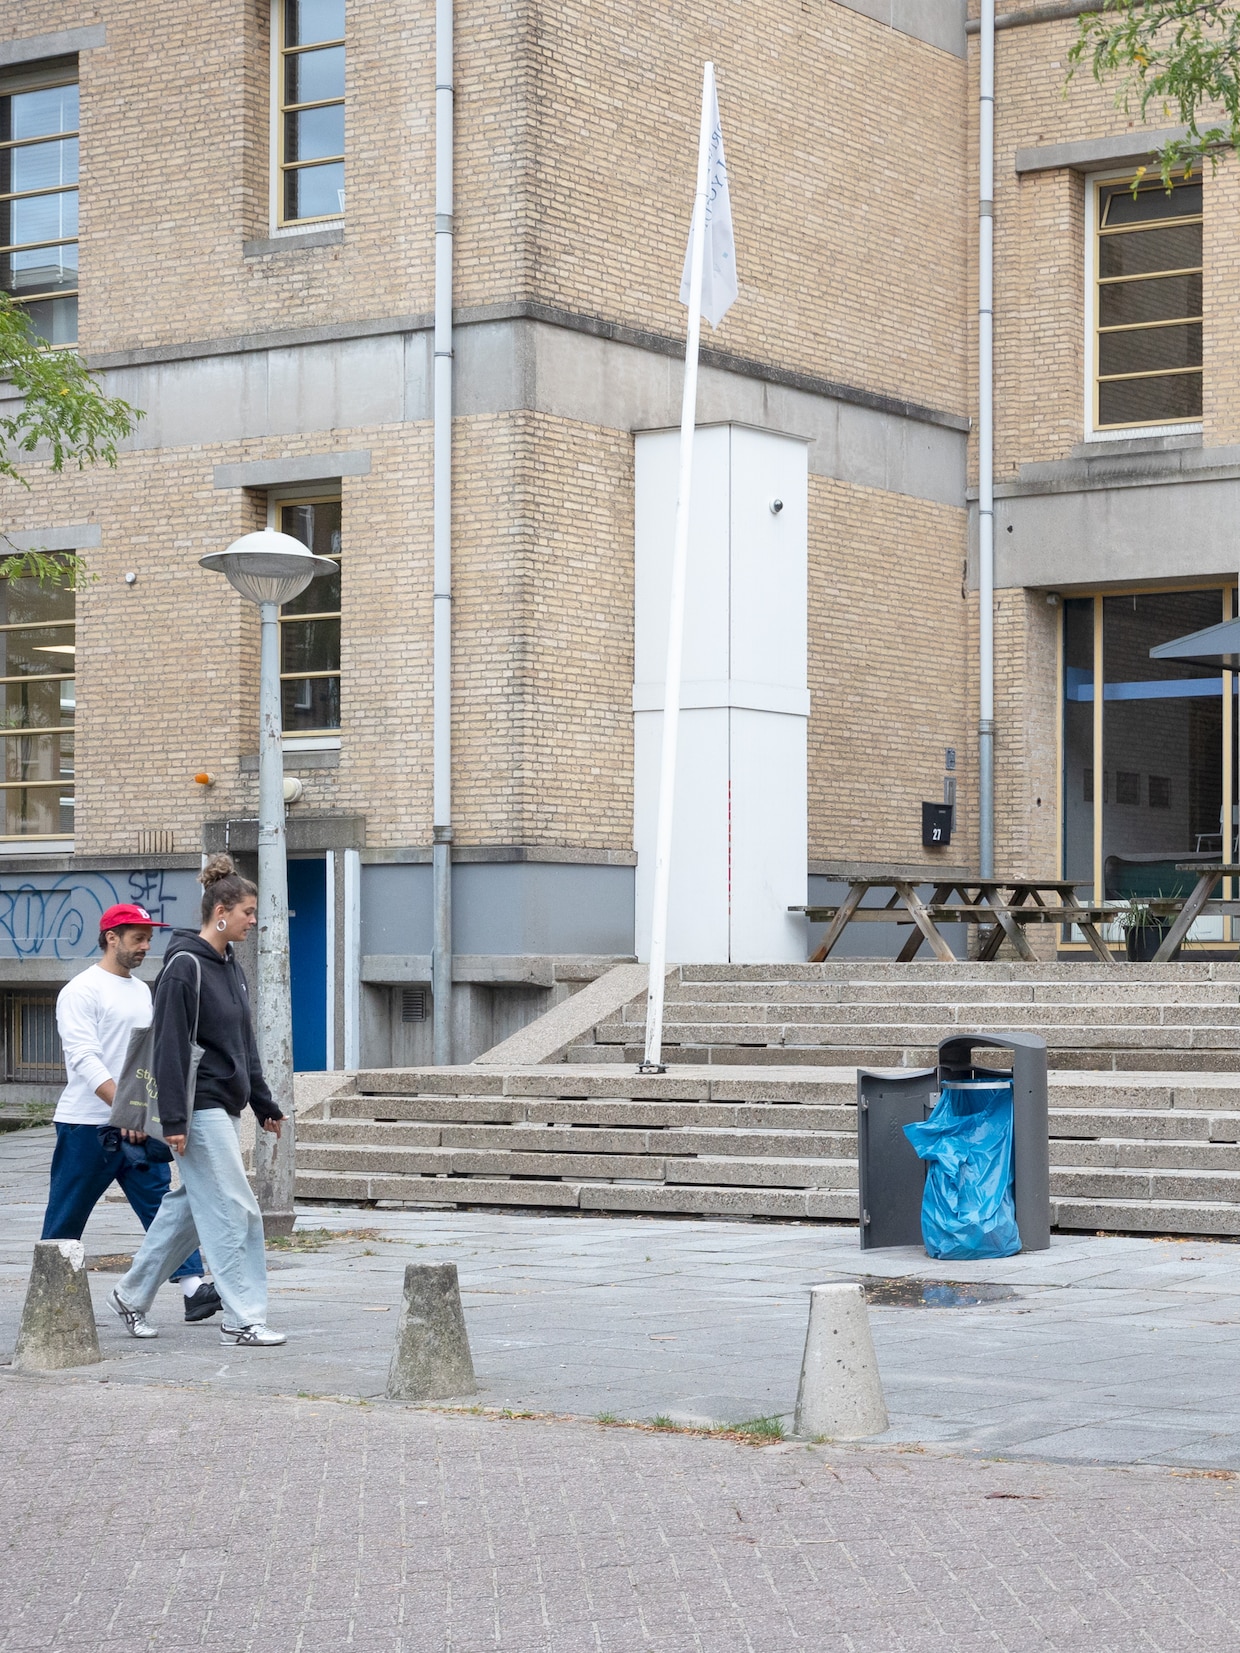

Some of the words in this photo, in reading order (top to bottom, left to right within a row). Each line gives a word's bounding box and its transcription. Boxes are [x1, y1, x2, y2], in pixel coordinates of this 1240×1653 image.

[932, 828, 941, 840] 27
[128, 869, 177, 902] SFL
[137, 908, 150, 919] B
